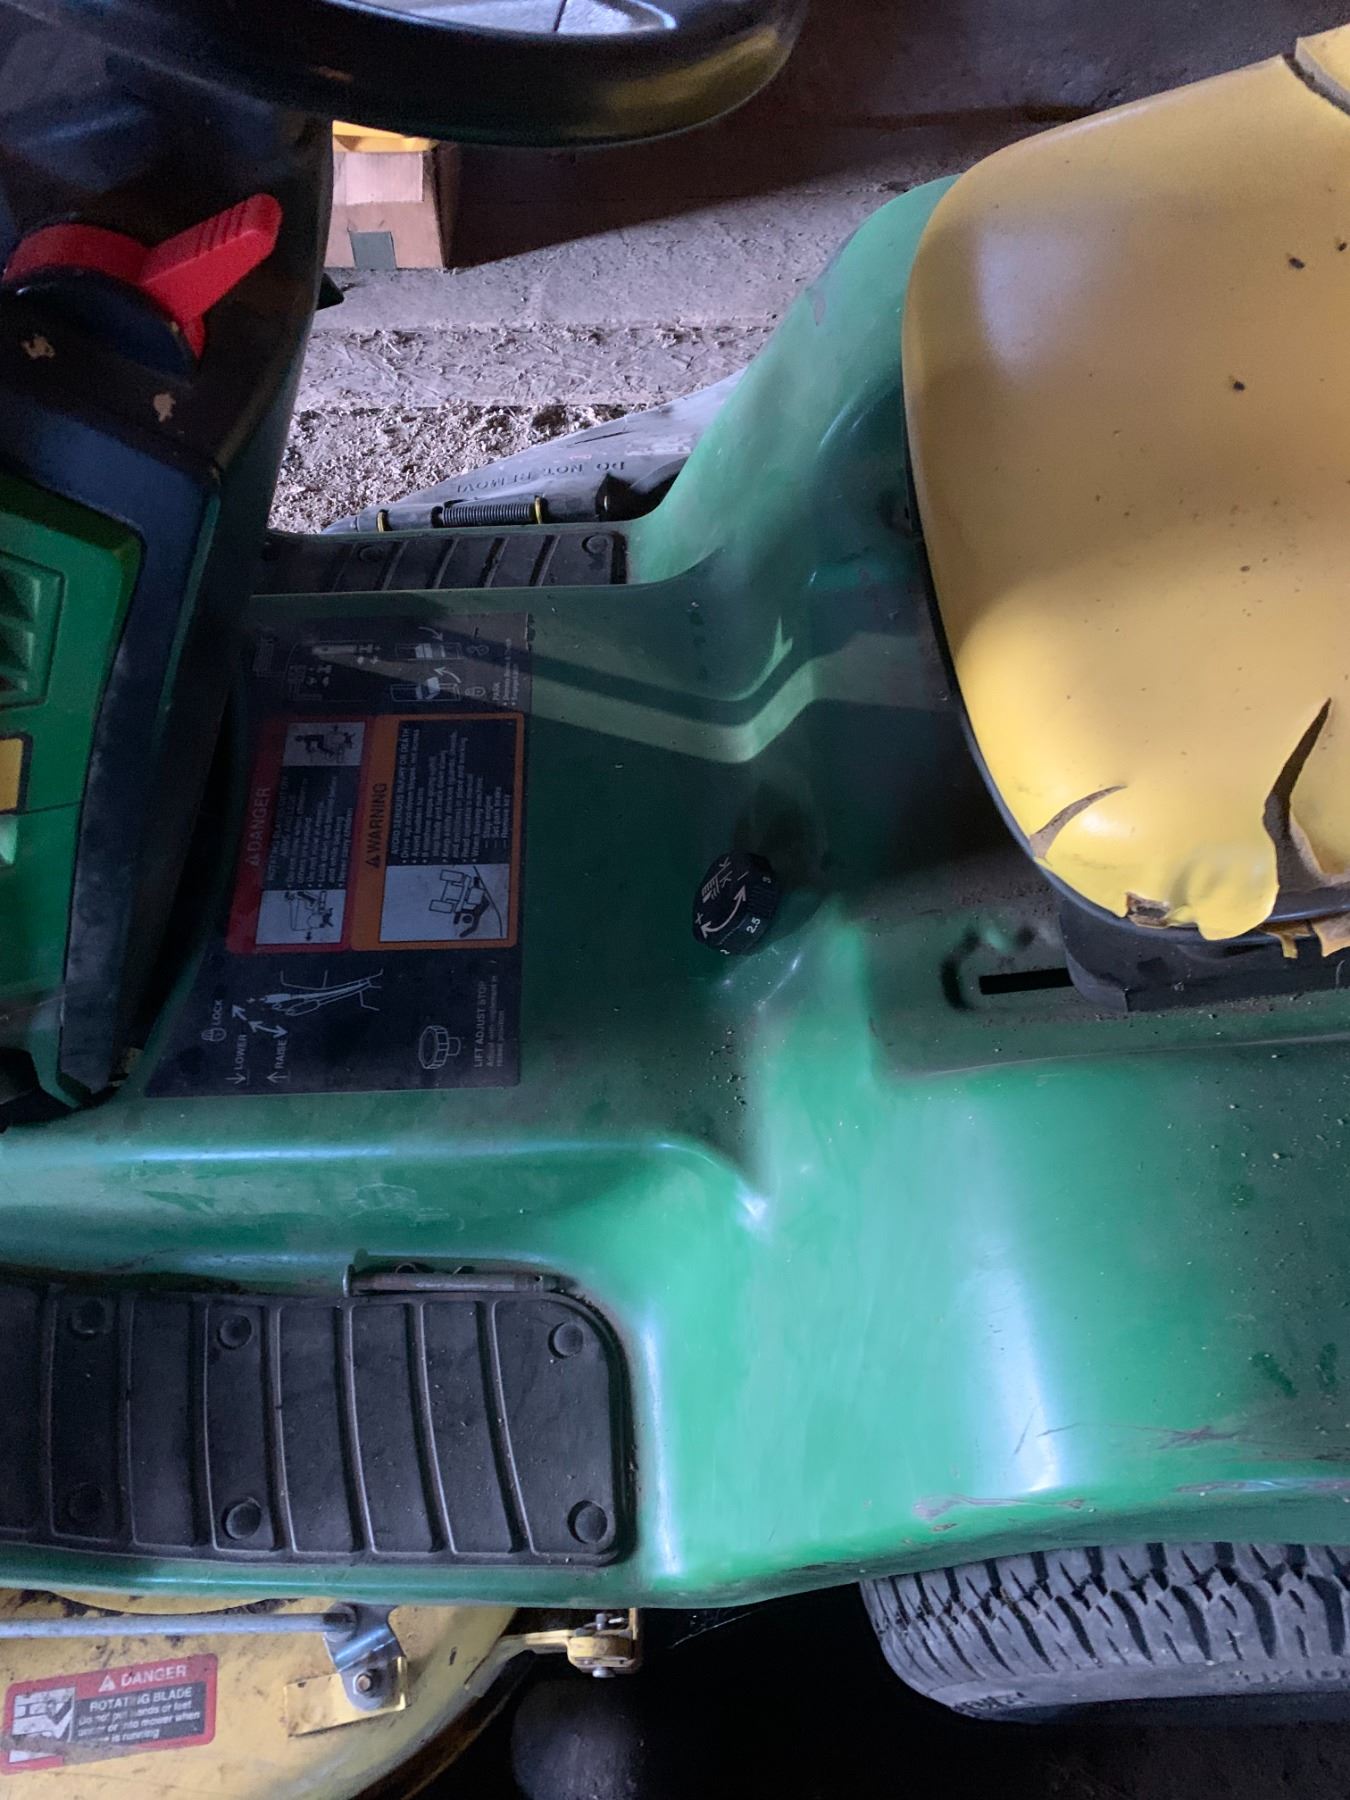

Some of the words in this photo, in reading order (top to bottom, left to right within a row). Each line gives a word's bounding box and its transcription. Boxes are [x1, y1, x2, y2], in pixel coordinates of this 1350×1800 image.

[544, 463, 583, 476] NOT
[597, 461, 625, 471] DO
[247, 787, 271, 851] DANGER
[367, 783, 387, 853] WARNING
[476, 980, 487, 1005] STOP
[211, 1000, 223, 1025] LOCK
[474, 1007, 485, 1045] ADJUST
[233, 1034, 247, 1070] LOWER
[274, 1039, 287, 1069] RAISE
[473, 1047, 484, 1067] LIFT
[121, 1664, 187, 1687] DANGER
[89, 1694, 150, 1712] ROTATG
[152, 1687, 193, 1702] BLADE
